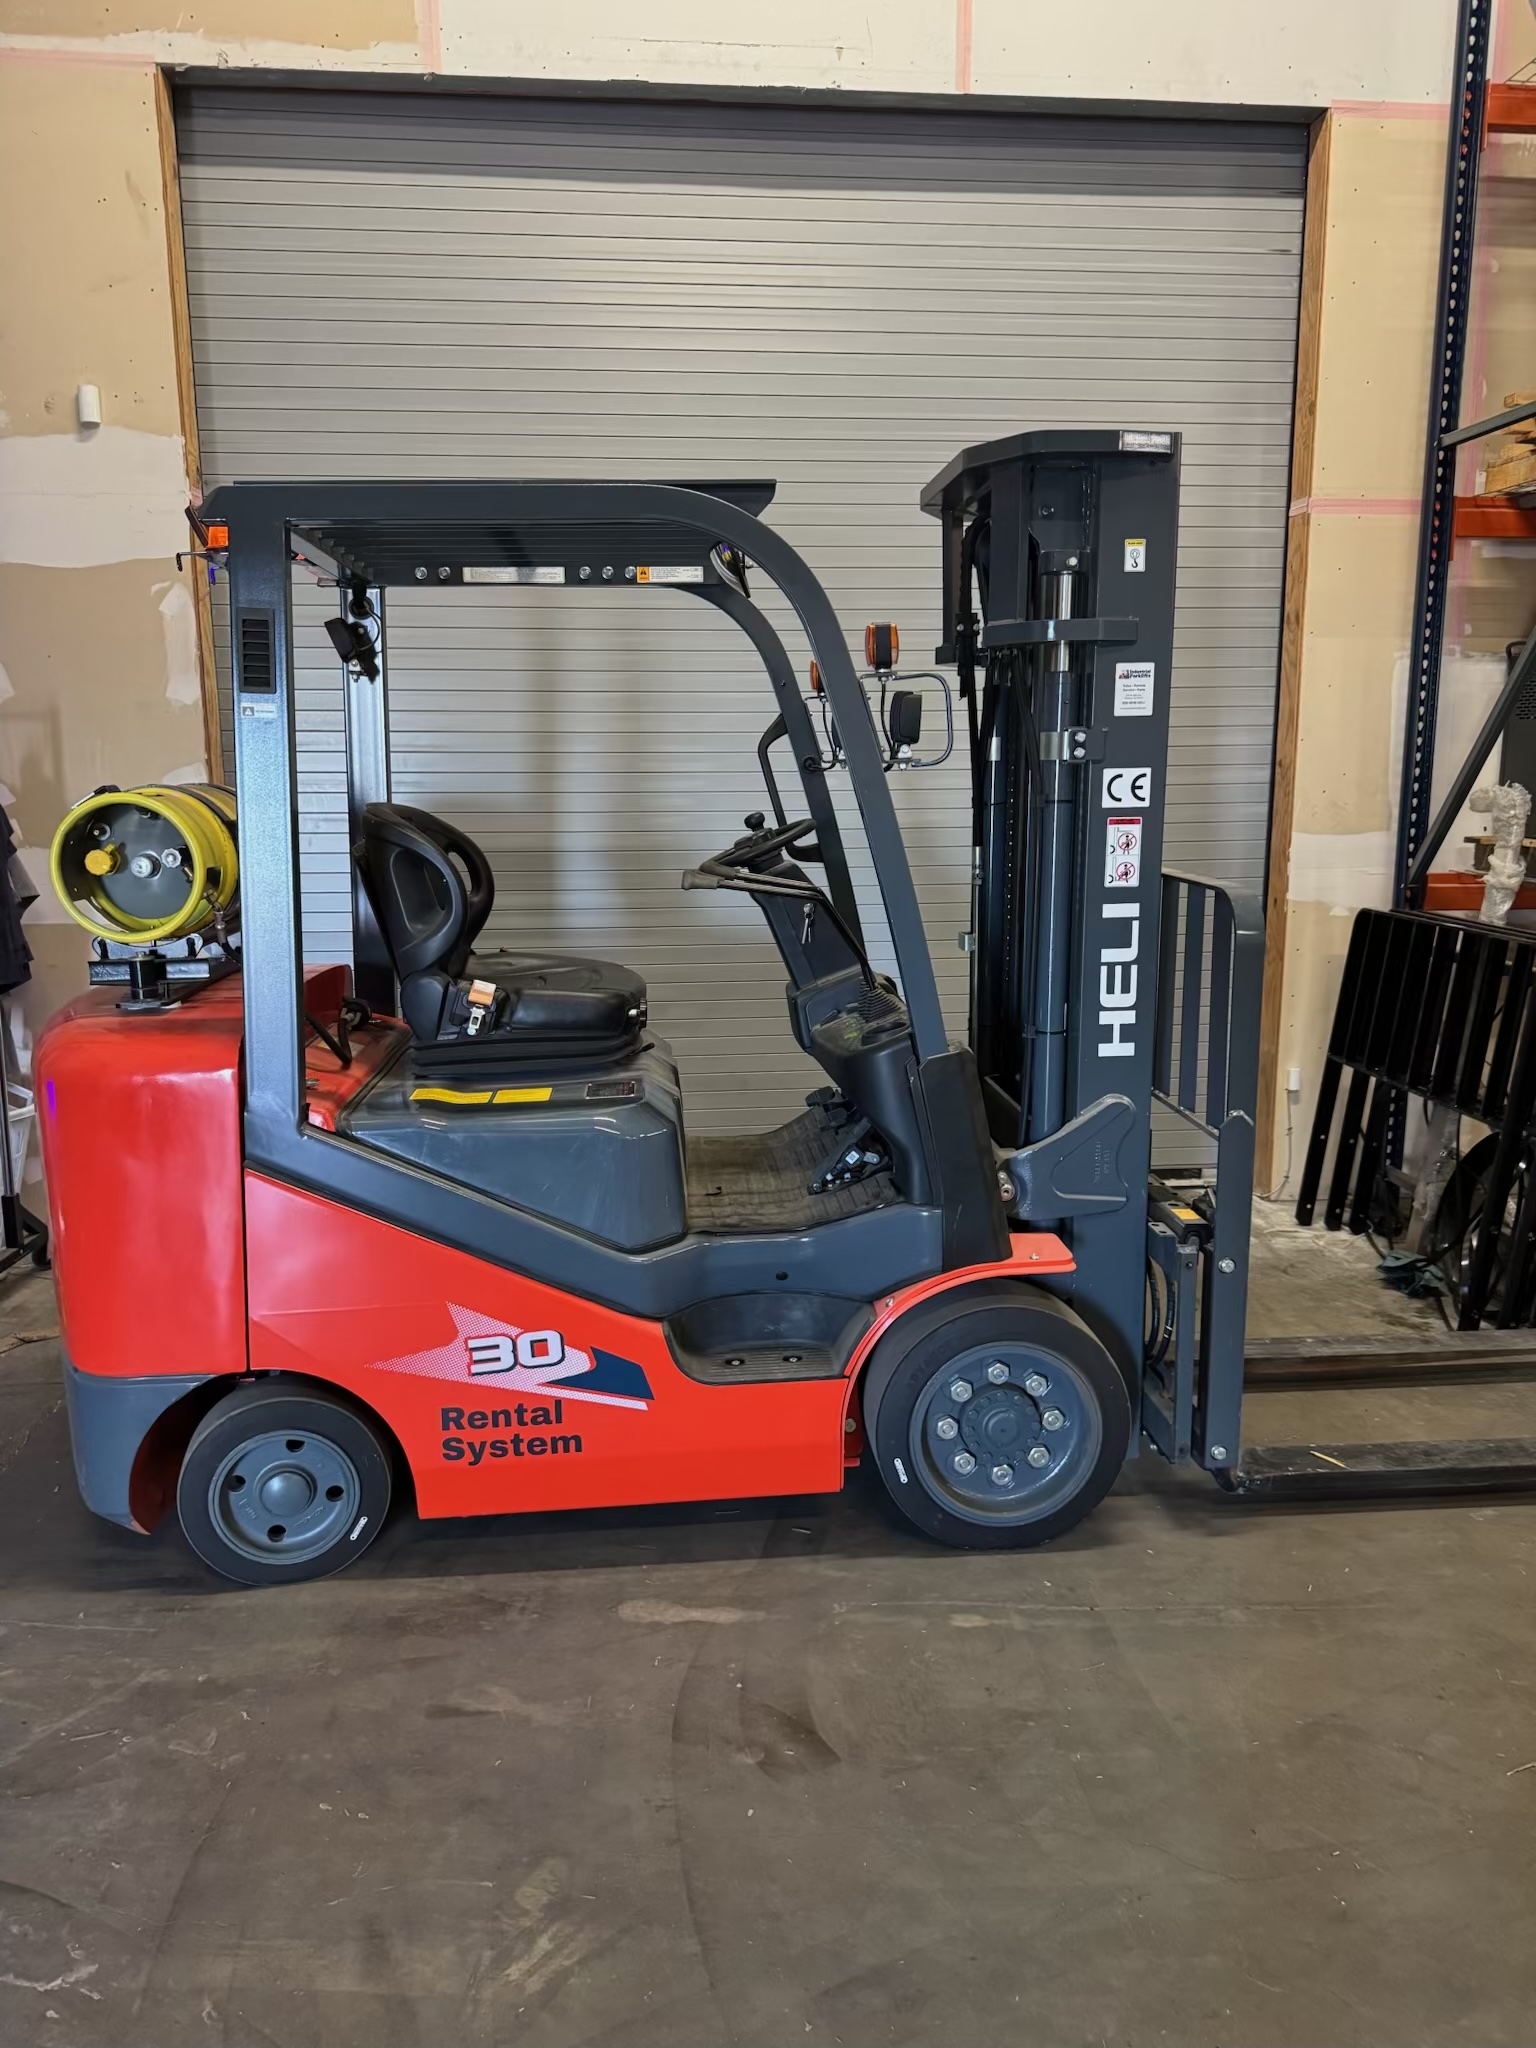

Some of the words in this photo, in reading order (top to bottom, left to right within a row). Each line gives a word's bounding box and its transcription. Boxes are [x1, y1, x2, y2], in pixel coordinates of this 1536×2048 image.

[1106, 773, 1147, 802] CE
[1097, 903, 1141, 1057] HELI
[466, 1329, 566, 1377] 30
[440, 1399, 563, 1431] Rental
[441, 1433, 583, 1466] System
